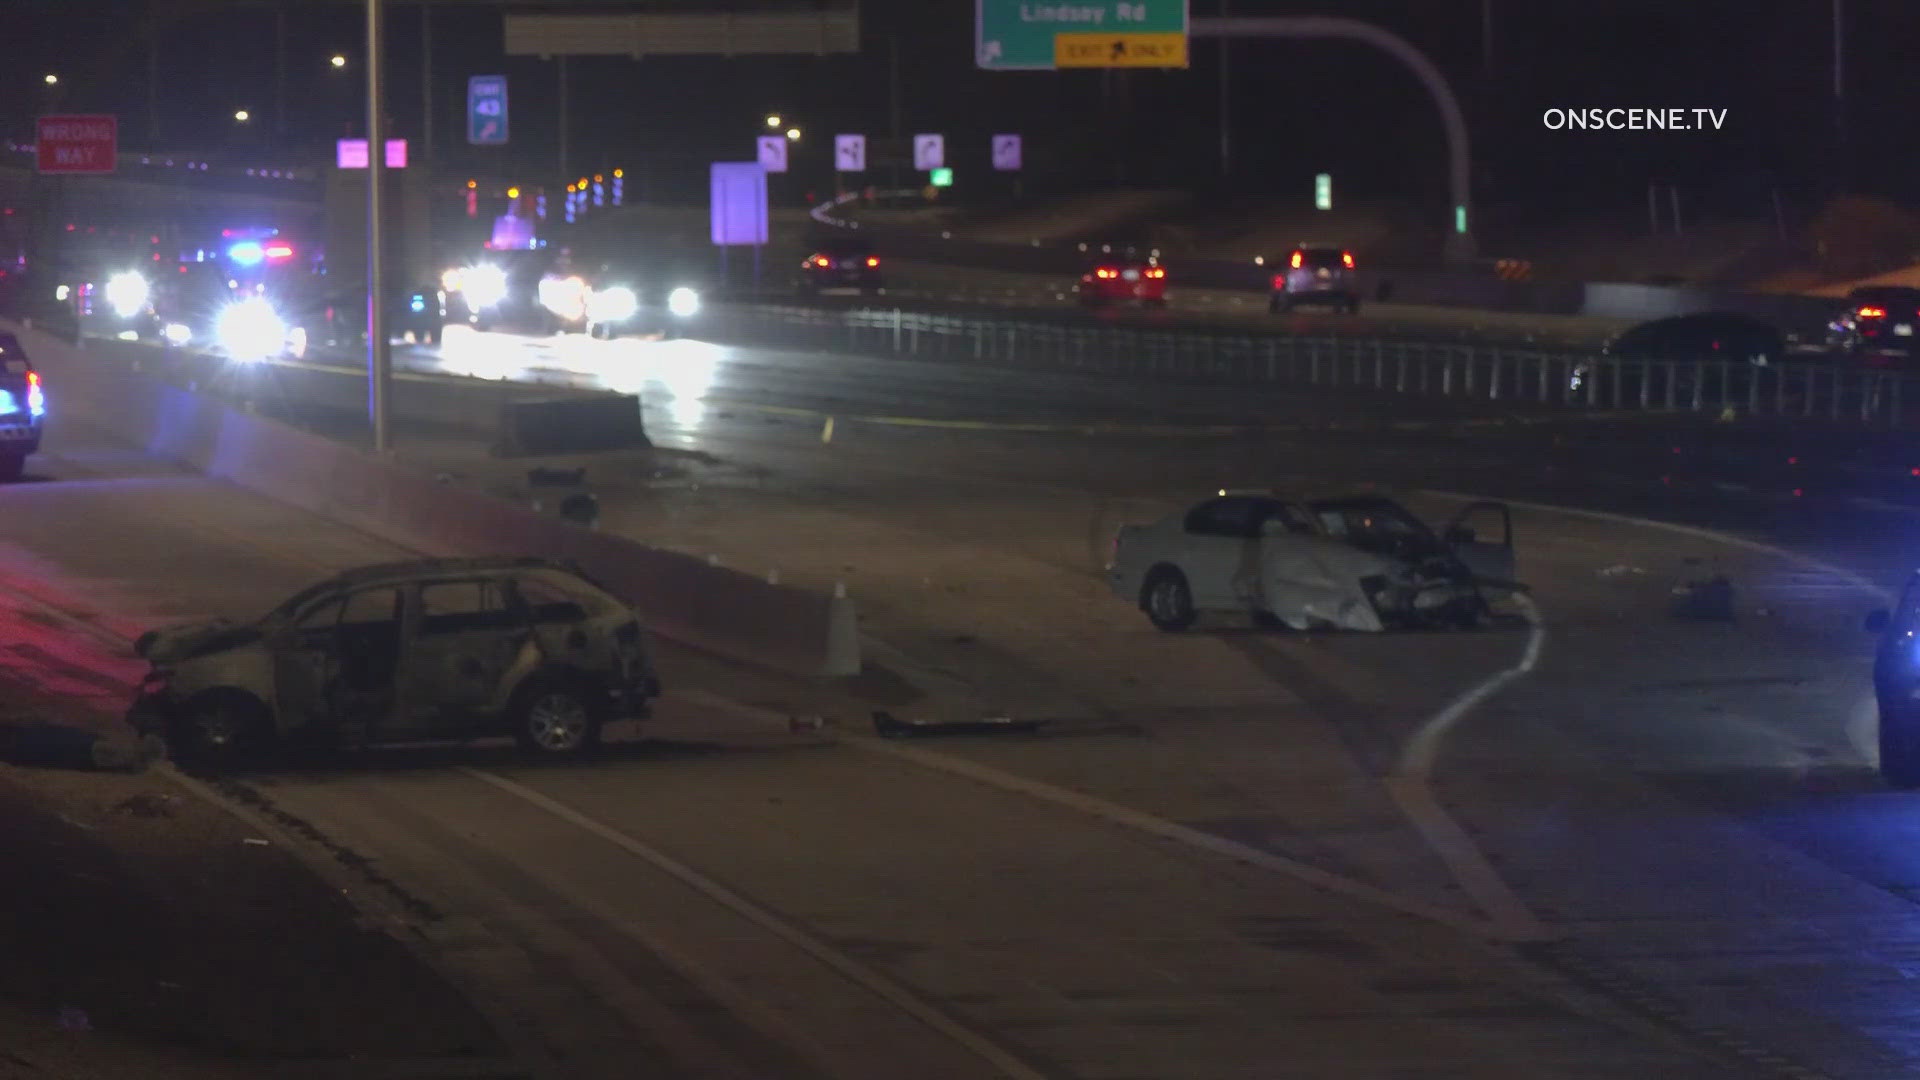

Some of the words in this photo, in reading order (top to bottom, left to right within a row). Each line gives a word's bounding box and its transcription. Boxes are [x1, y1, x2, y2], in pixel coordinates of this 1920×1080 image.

[1021, 4, 1105, 24] Lindsay
[1117, 3, 1146, 21] Rd
[42, 124, 111, 140] WRONG
[56, 147, 96, 164] WAY
